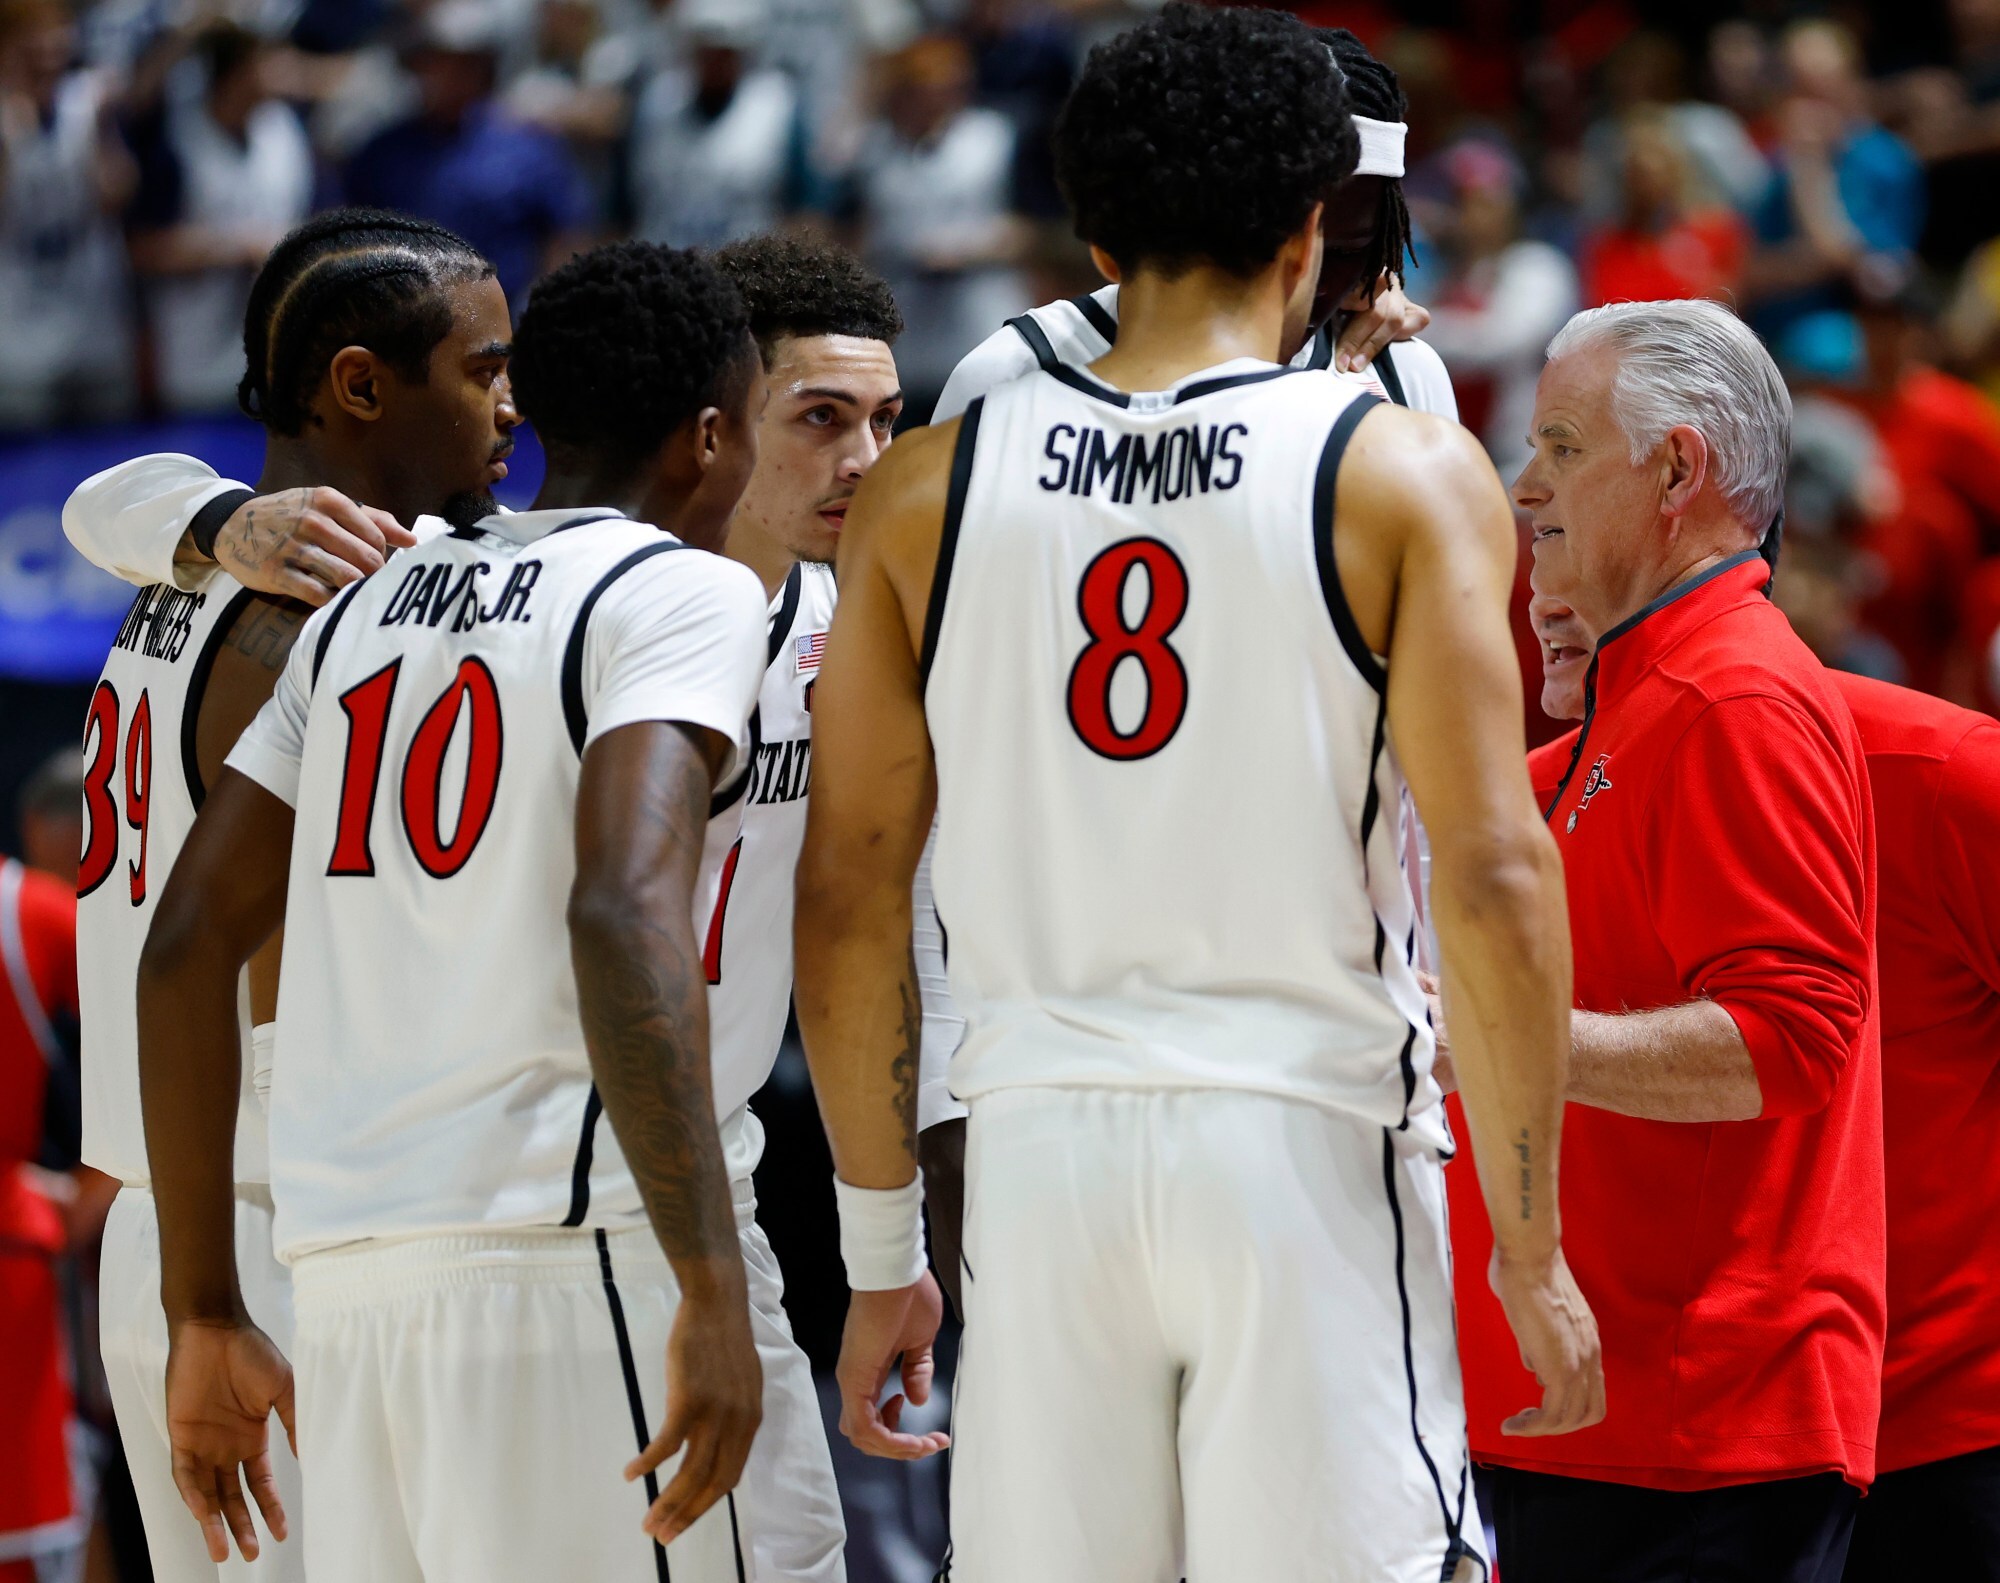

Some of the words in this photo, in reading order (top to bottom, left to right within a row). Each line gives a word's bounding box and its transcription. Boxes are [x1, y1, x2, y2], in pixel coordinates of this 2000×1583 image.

[1039, 422, 1249, 504] SIMMONS
[378, 561, 491, 633] DAVIS
[477, 559, 543, 624] JR.
[1067, 536, 1189, 762] 8
[76, 679, 152, 908] 39
[325, 653, 503, 880] 10
